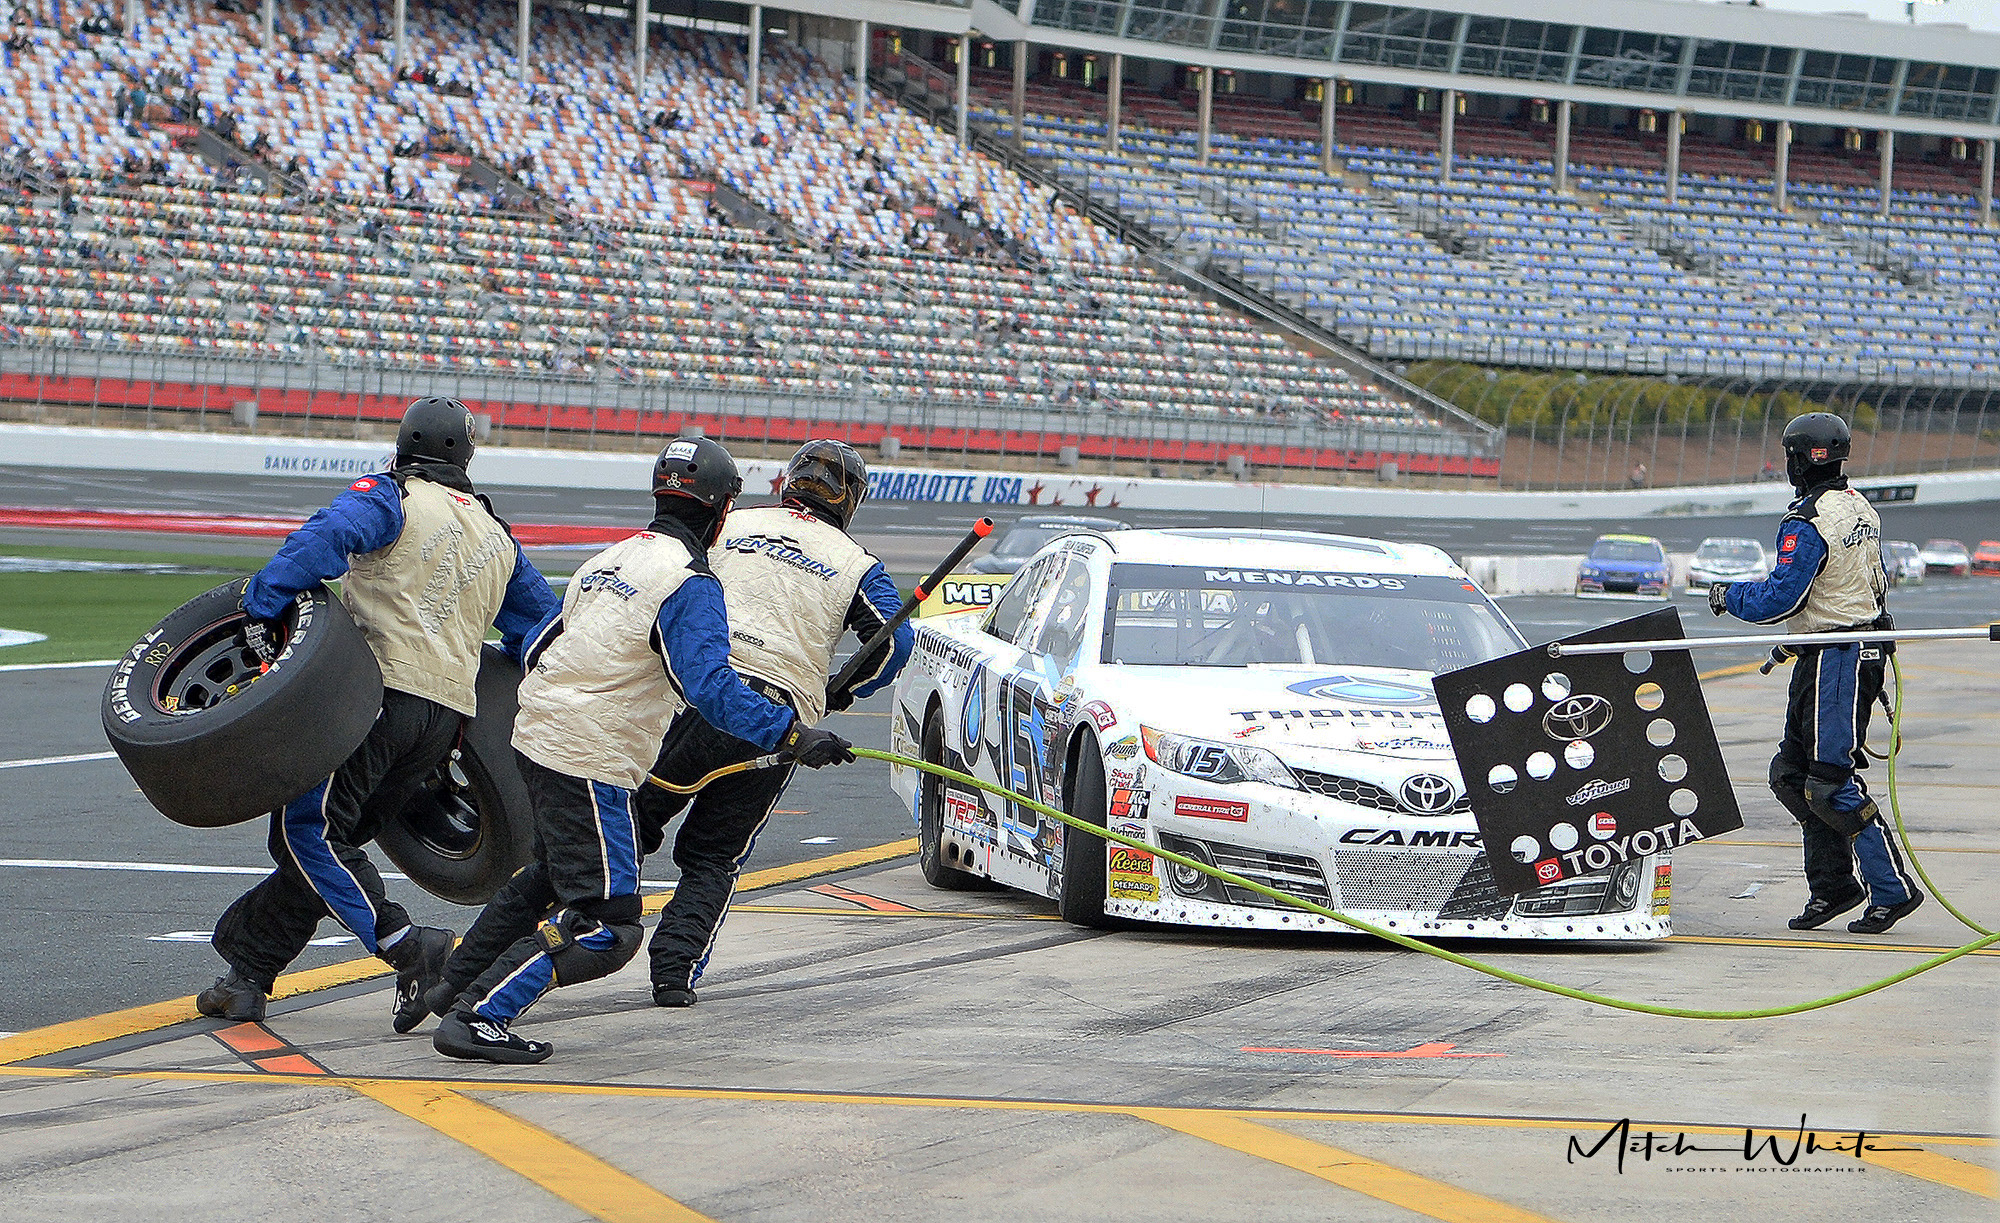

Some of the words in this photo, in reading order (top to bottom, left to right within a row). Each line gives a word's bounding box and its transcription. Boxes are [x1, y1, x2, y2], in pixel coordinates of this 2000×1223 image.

[264, 456, 298, 470] BANK
[302, 457, 317, 471] OF
[319, 459, 376, 473] AMERICA
[867, 472, 977, 501] CHARLOTTE
[982, 477, 1022, 504] USA
[725, 536, 840, 579] VENTURINI
[764, 550, 831, 583] MOTORSPORTS
[1203, 570, 1406, 591] MENARDS
[268, 590, 314, 674] ENERAL
[144, 642, 174, 668] RR2
[110, 627, 165, 724] GENERAL
[1181, 744, 1226, 774] 15
[1110, 849, 1153, 873] Reese's
[1562, 818, 1704, 875] TOYOTA
